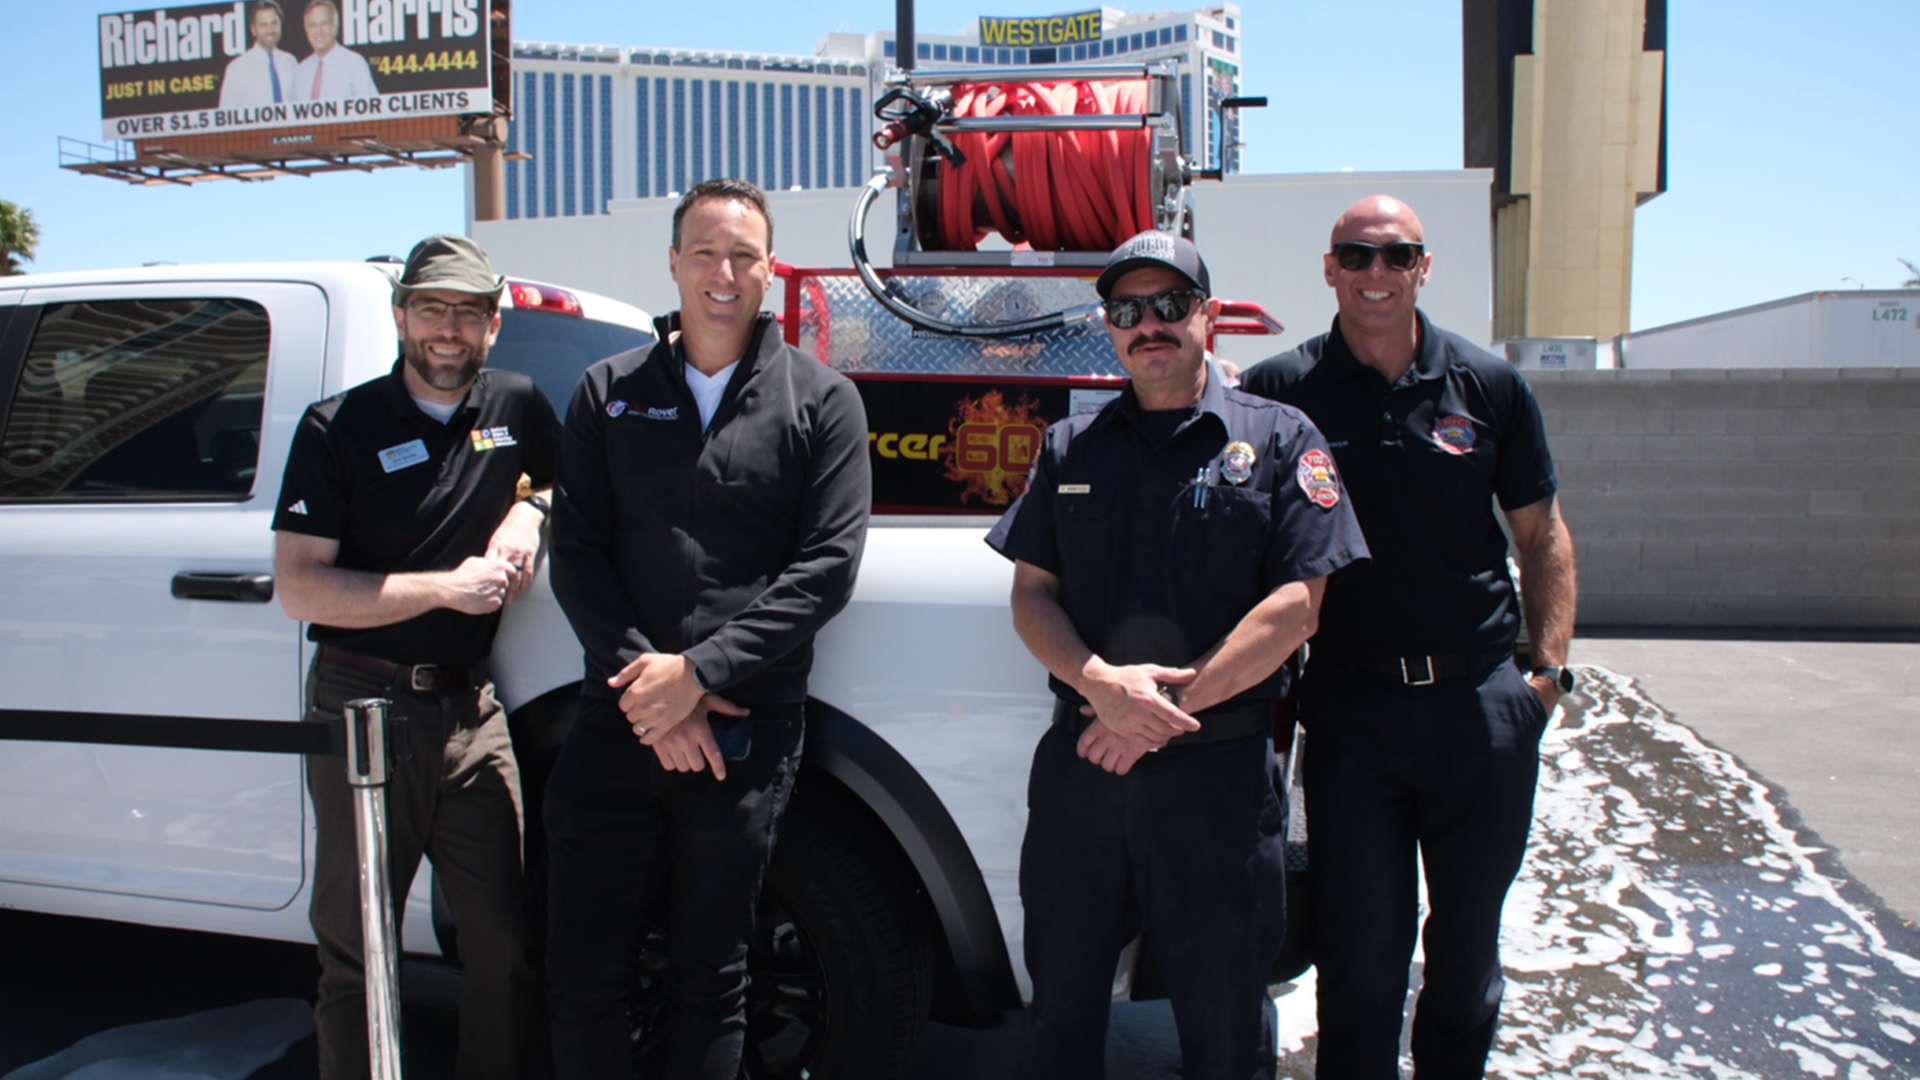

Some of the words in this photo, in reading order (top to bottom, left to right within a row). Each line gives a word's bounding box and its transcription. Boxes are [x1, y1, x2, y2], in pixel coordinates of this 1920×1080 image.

[101, 2, 247, 68] Richard
[342, 0, 479, 46] Harris
[981, 12, 1101, 45] WESTGATE
[378, 49, 479, 75] 444.4444
[106, 81, 144, 100] JUST
[148, 79, 165, 95] IN
[170, 74, 215, 93] CASE
[117, 116, 164, 135] OVER
[170, 112, 209, 131] $1.5
[214, 105, 287, 127] BILLION
[293, 101, 337, 120] WON
[344, 97, 382, 116] FOR
[388, 91, 469, 112] CLIENTS
[273, 135, 313, 144] LAMAR
[1873, 308, 1907, 321] L472
[956, 421, 1042, 475] 60
